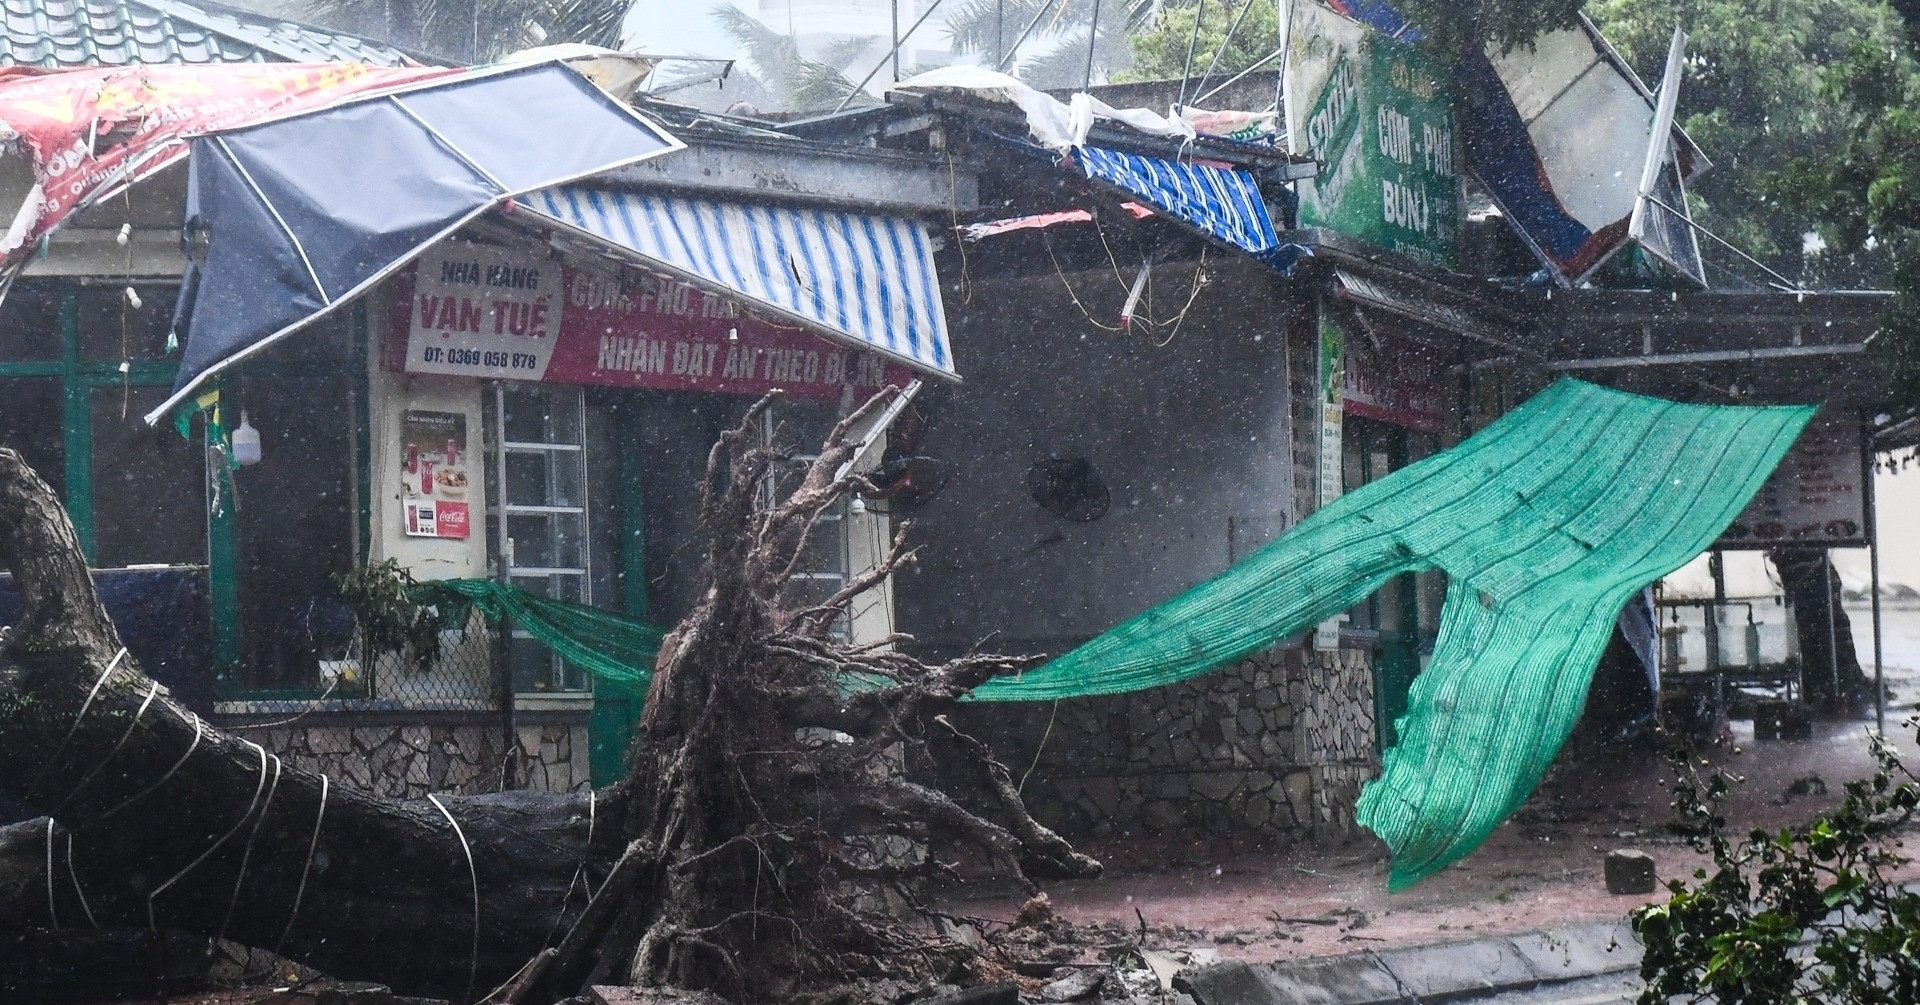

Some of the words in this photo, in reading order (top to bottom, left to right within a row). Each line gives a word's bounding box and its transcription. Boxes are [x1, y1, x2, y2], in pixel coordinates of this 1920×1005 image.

[1378, 104, 1412, 165] CƠM
[1382, 173, 1421, 233] BÚN
[441, 259, 480, 286] NHÀ
[486, 262, 539, 290] HÀNG
[420, 294, 482, 338] VẠN
[492, 294, 552, 338] TUẾ
[424, 346, 442, 363] ĐT:
[447, 347, 480, 365] 0369
[483, 350, 508, 367] 058
[512, 351, 537, 369] 878
[597, 331, 667, 380] NHẬN
[763, 346, 820, 383] THEO
[439, 510, 465, 524] Coca-Cola
